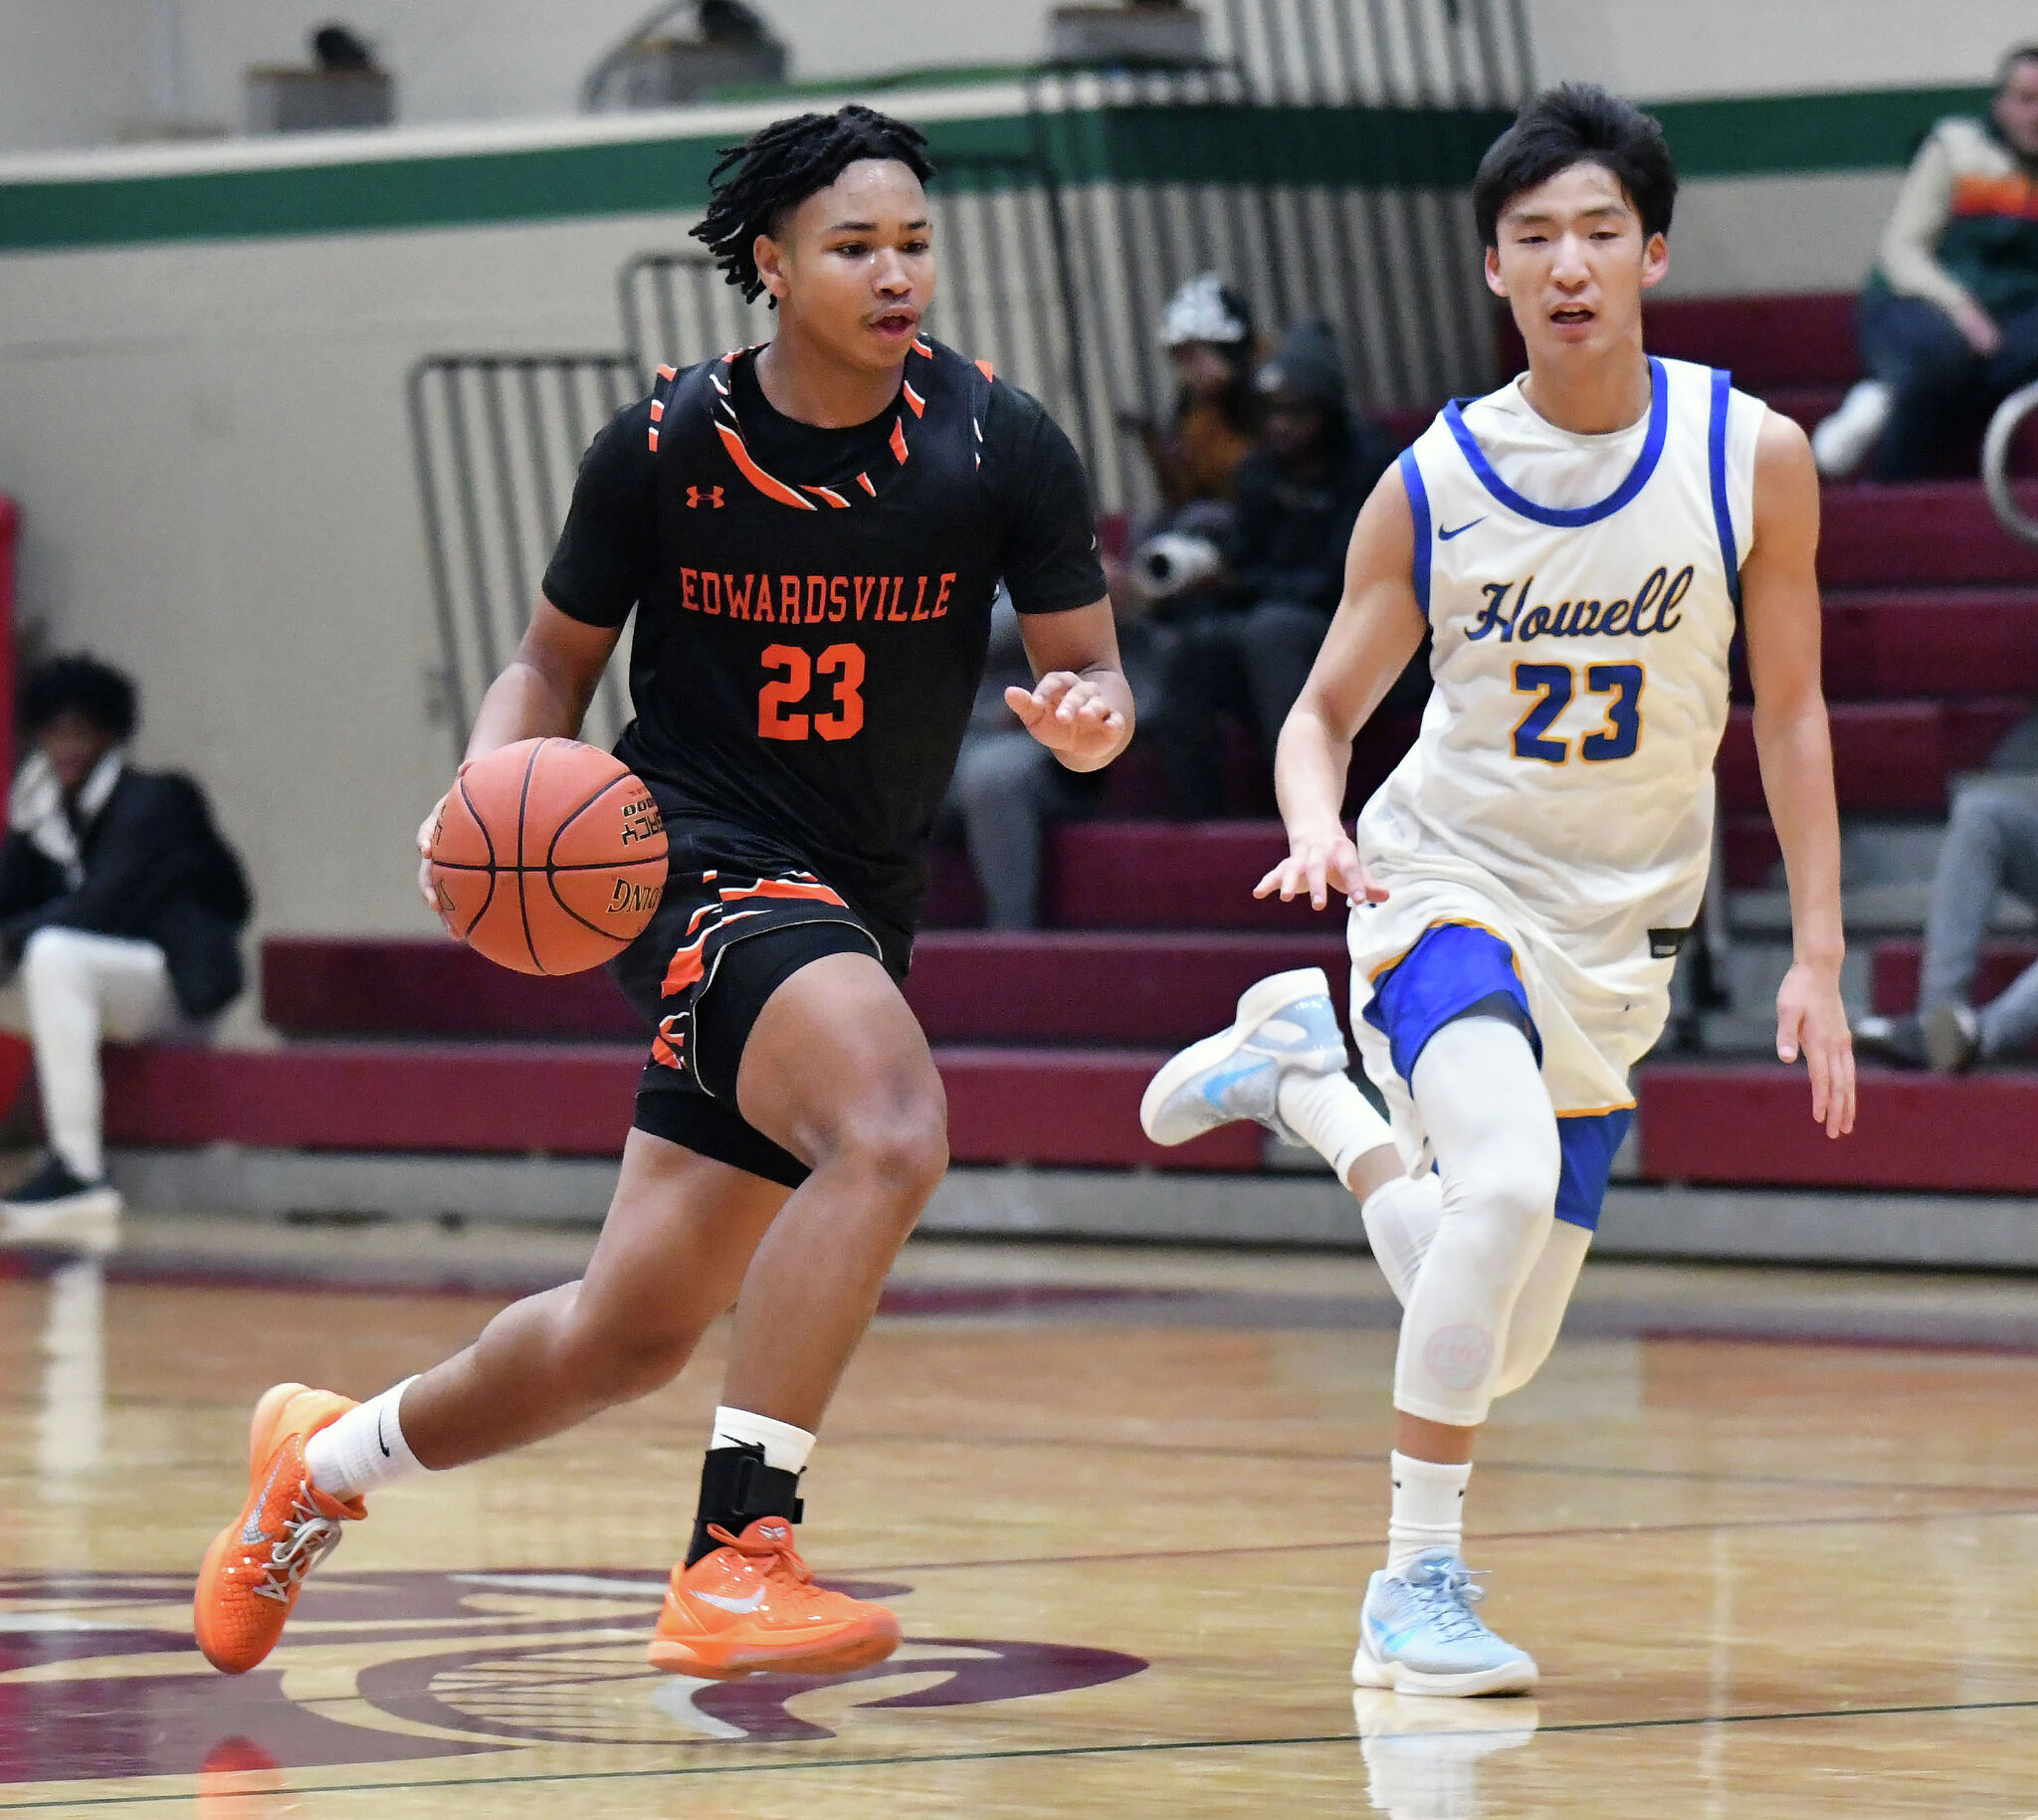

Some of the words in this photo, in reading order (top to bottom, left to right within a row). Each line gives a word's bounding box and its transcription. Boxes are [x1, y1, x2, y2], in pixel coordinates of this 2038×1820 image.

[681, 567, 956, 624] EDWARDSVILLE
[1465, 565, 1694, 642] Howell
[758, 643, 866, 741] 23
[1511, 660, 1645, 765] 23
